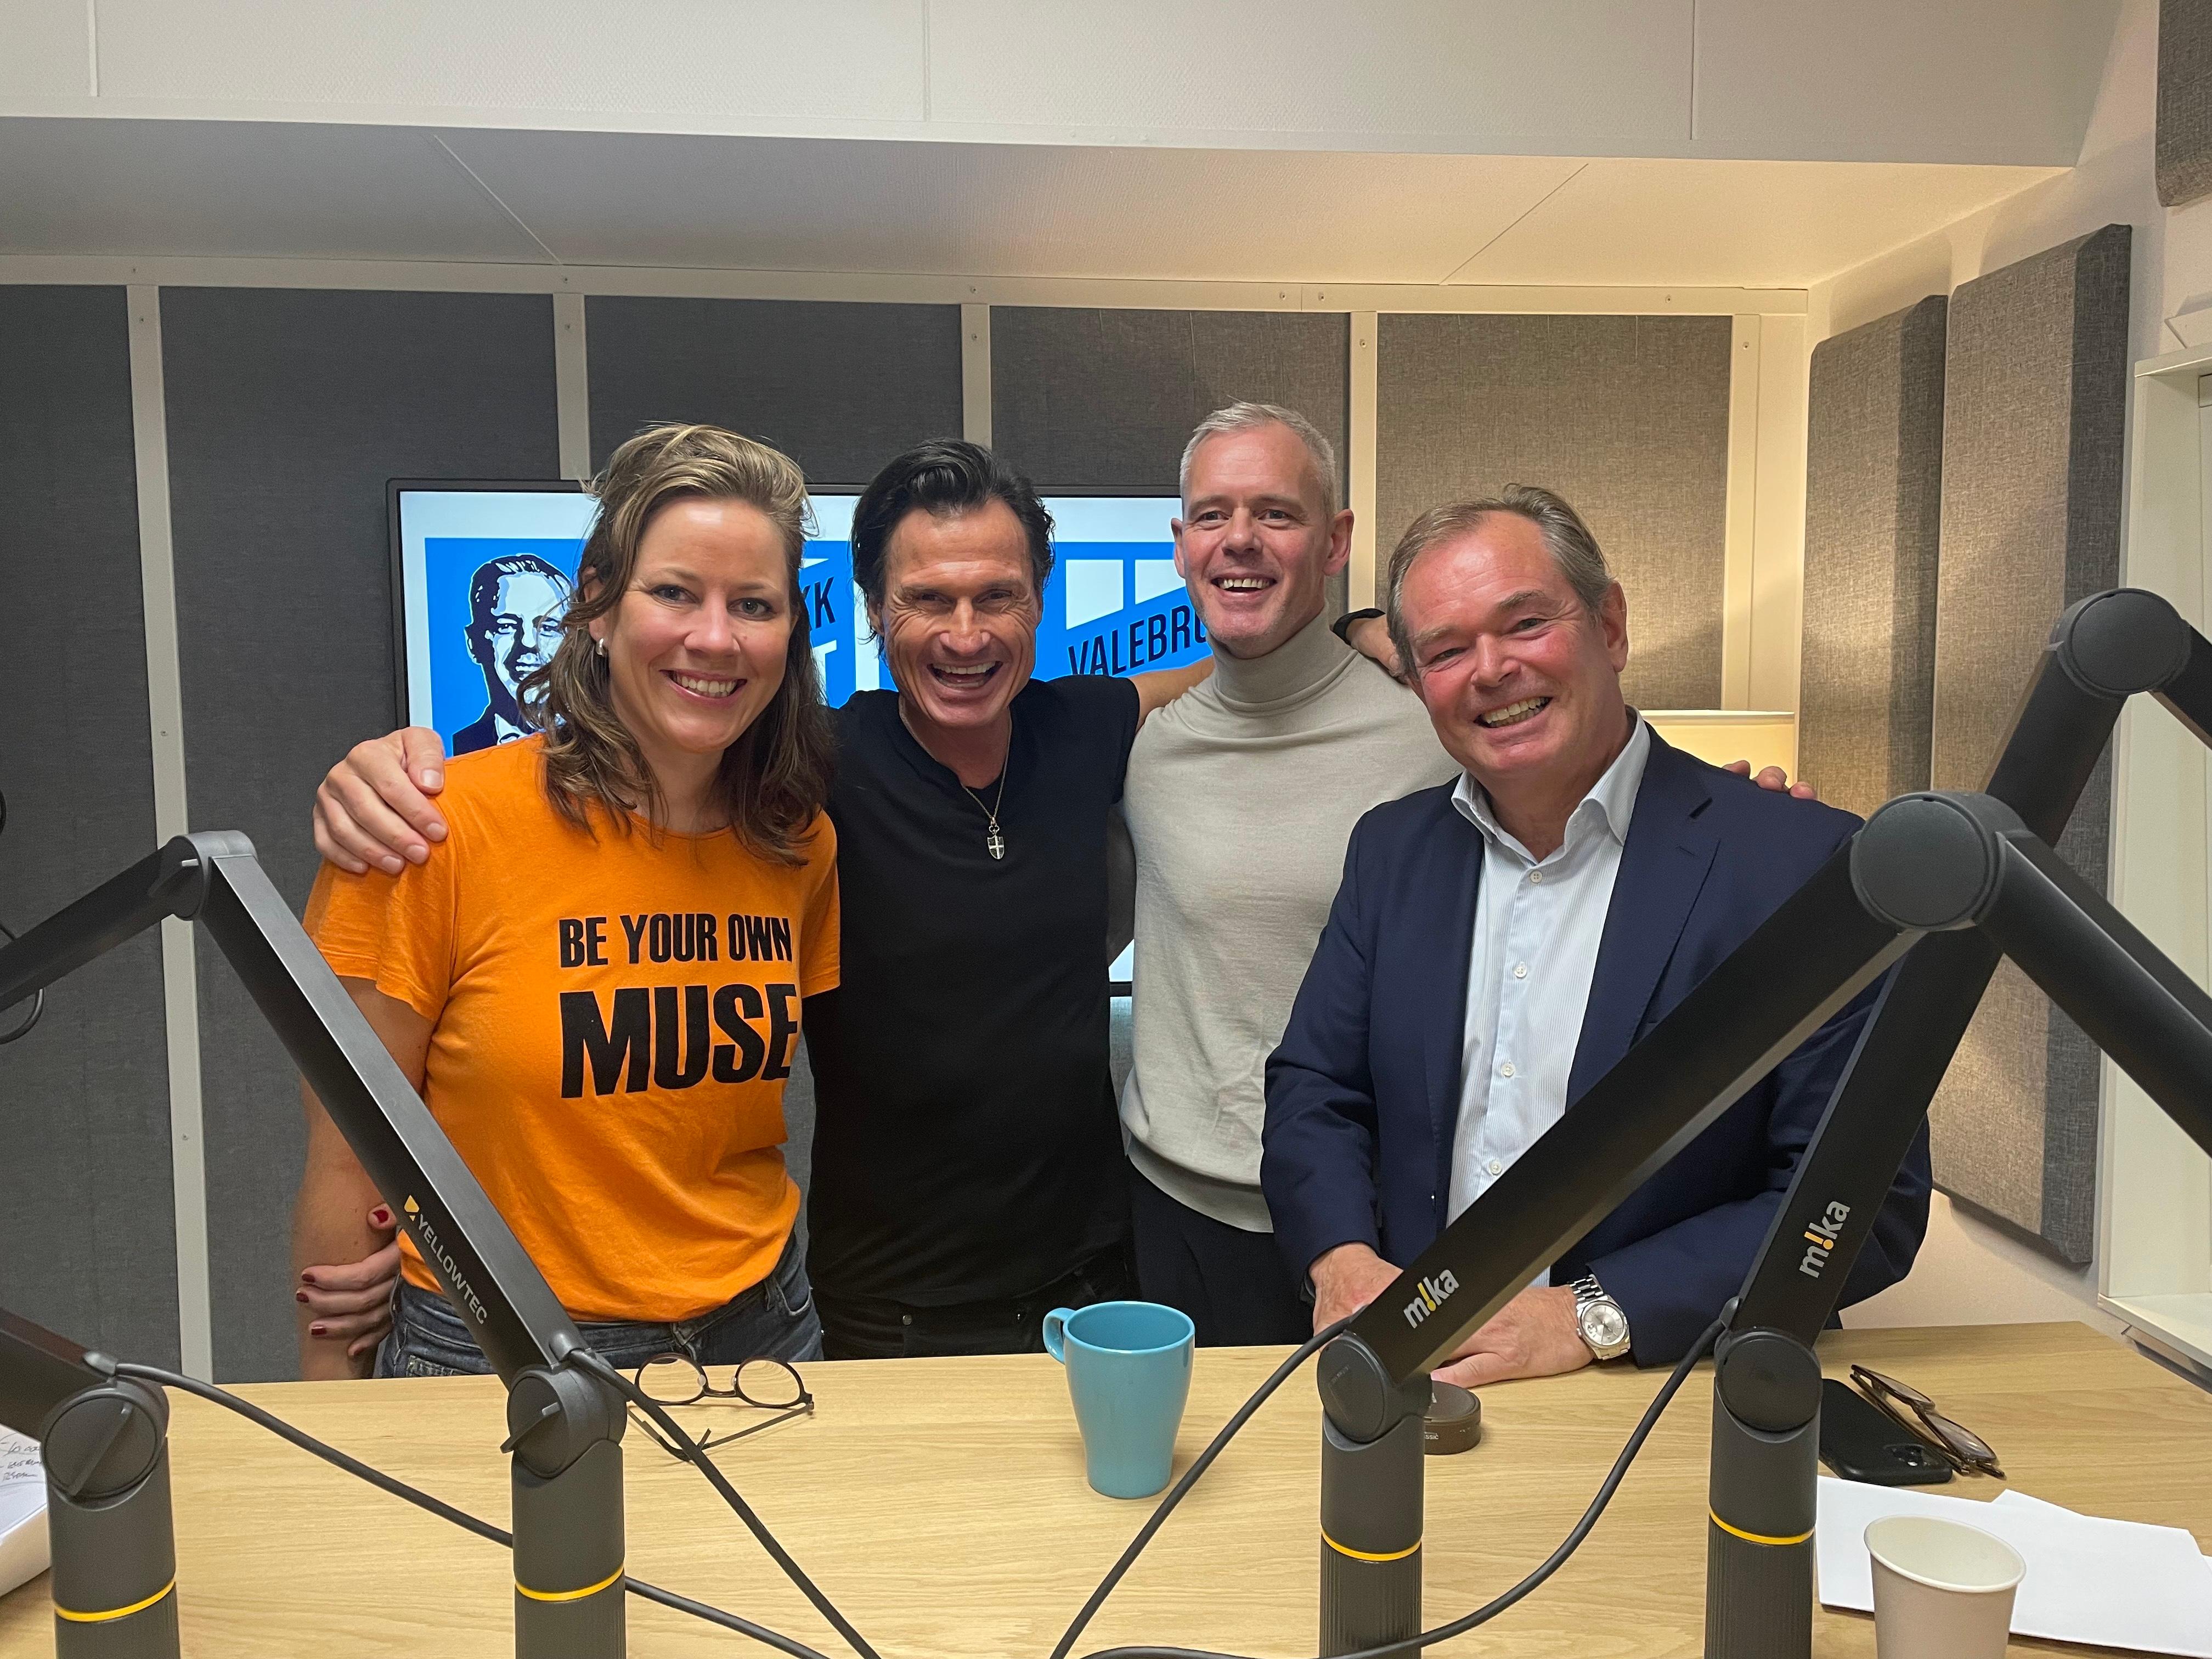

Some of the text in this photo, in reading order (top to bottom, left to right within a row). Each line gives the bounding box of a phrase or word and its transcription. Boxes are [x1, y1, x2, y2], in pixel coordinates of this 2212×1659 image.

[559, 913, 792, 968] BE YOUR OWN
[560, 984, 798, 1098] MUSE
[419, 1214, 487, 1324] YELLOWTEC
